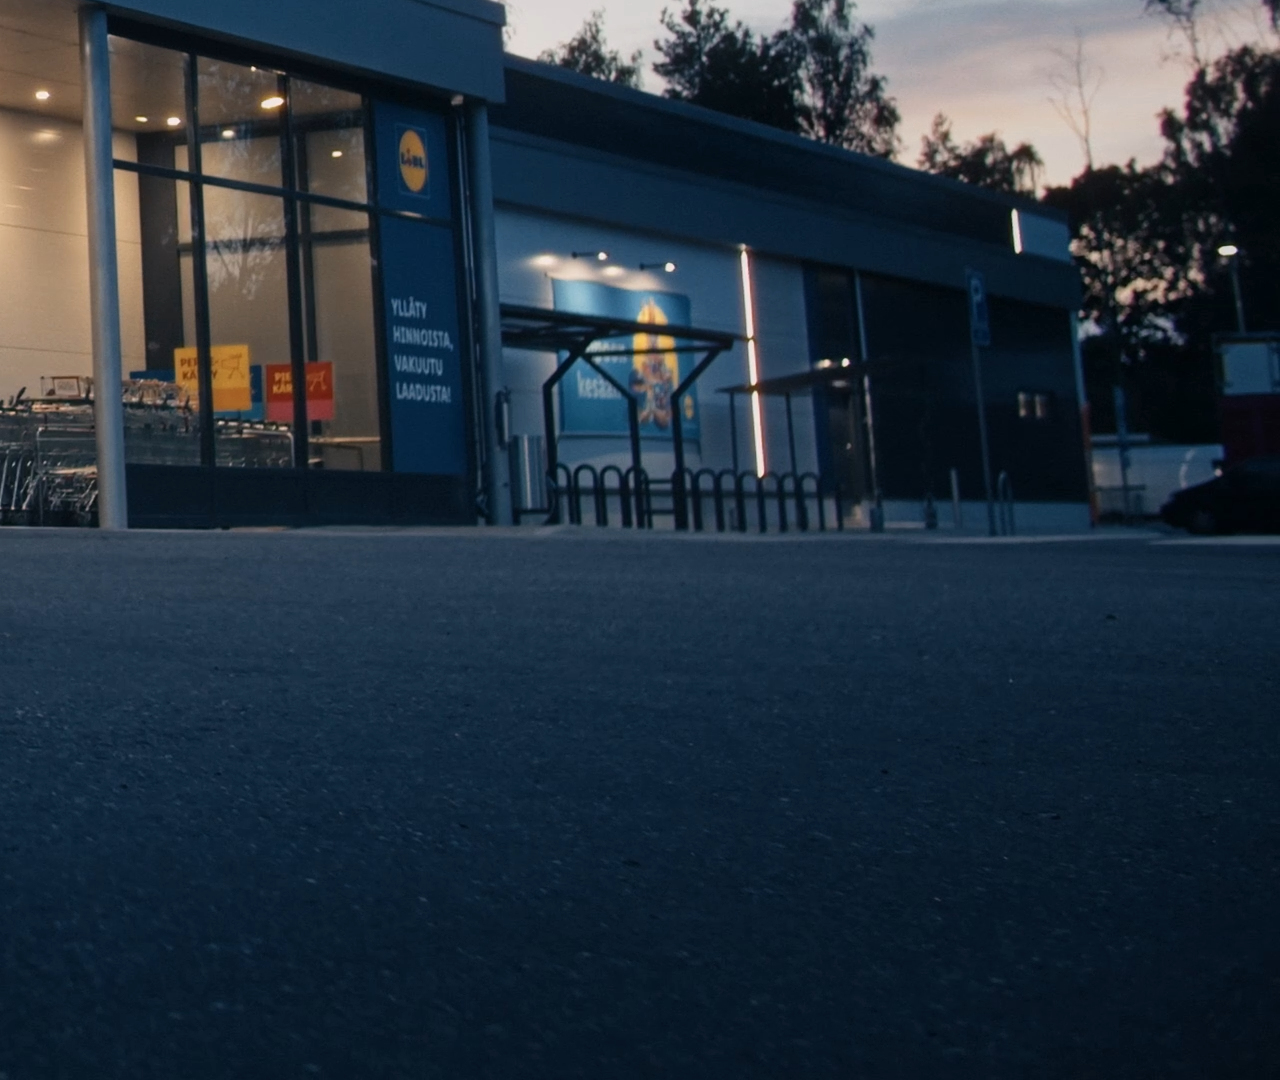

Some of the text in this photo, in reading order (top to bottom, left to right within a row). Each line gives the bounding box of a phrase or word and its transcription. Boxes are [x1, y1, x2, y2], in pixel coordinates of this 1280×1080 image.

[391, 296, 428, 320] YLLÄTY
[392, 325, 454, 352] HINNOISTA,
[394, 354, 444, 377] VAKUUTU
[395, 381, 452, 404] LAADUSTA!
